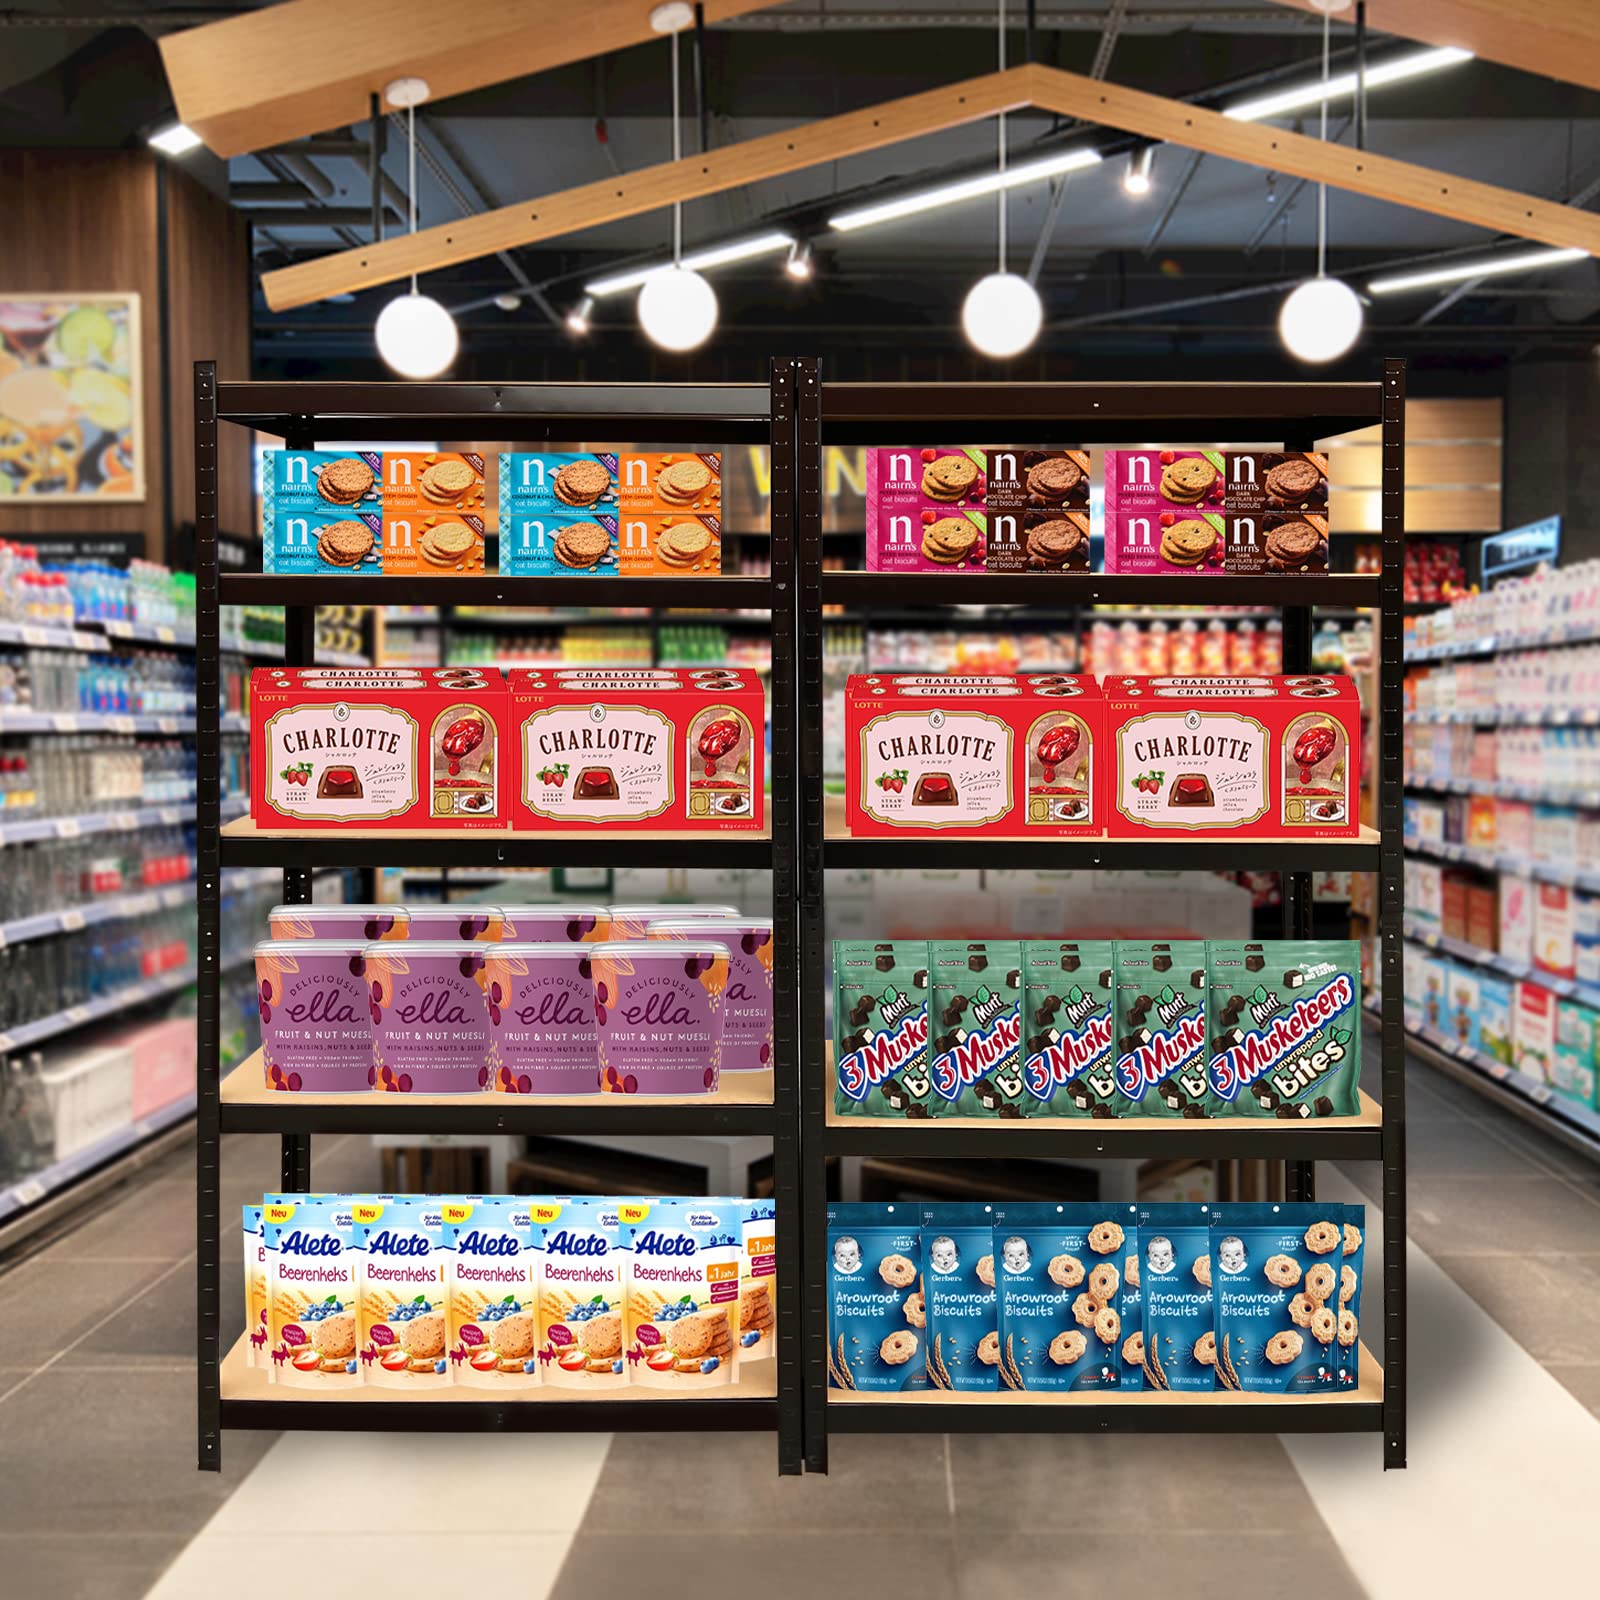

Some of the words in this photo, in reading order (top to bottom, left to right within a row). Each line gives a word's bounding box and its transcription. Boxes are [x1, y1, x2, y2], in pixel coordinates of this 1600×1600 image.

[287, 456, 308, 483] n
[390, 458, 411, 484] n
[523, 458, 544, 485] n
[626, 459, 647, 486] n
[890, 454, 912, 481] n
[995, 454, 1016, 480] n
[1128, 456, 1150, 483] n
[1234, 456, 1255, 482] n
[287, 518, 308, 545] n
[390, 520, 411, 546] n
[523, 520, 544, 547] n
[626, 521, 647, 548] n
[890, 516, 912, 543] n
[995, 516, 1016, 542] n
[1128, 518, 1150, 545] n
[1234, 518, 1255, 544] n
[320, 670, 398, 678] CHARLOTTE
[326, 680, 404, 688] CHARLOTTE
[582, 681, 660, 689] CHARLOTTE
[1171, 678, 1249, 686] CHARLOTTE
[921, 687, 999, 695] CHARLOTTE
[1177, 688, 1255, 696] CHARLOTTE
[283, 727, 400, 755] CHARLOTTE
[539, 728, 657, 756] CHARLOTTE
[878, 734, 996, 762] CHARLOTTE
[1134, 735, 1252, 763] CHARLOTTE
[290, 975, 360, 997] DELICIOUSLY
[400, 976, 470, 998] DELICIOUSLY
[520, 977, 590, 999] DELICIOUSLY
[626, 977, 696, 999] DELICIOUSLY
[881, 992, 910, 1022] Mint
[974, 992, 1004, 1022] Mint
[1067, 992, 1096, 1022] Mint
[1158, 992, 1188, 1022] Mint
[1251, 992, 1280, 1022] Mint
[275, 1030, 300, 1039] FRUIT
[304, 1030, 310, 1039] &
[316, 1030, 338, 1039] NUT
[385, 1032, 410, 1040] FRUIT
[414, 1032, 421, 1040] &
[426, 1032, 448, 1040] NUT
[453, 1032, 485, 1040] MUESLI
[505, 1032, 530, 1041] FRUIT
[534, 1032, 540, 1041] &
[546, 1032, 568, 1041] NUT
[611, 1032, 636, 1041] FRUIT
[640, 1032, 647, 1041] &
[652, 1032, 674, 1041] NUT
[679, 1032, 710, 1041] MUESLI
[1214, 1058, 1233, 1090] 3
[1234, 978, 1348, 1080] Musketeers
[1274, 1029, 1324, 1072] unwrapped
[844, 1058, 863, 1090] 3
[936, 1058, 956, 1090] 3
[1030, 1058, 1049, 1090] 3
[1120, 1058, 1140, 1090] 3
[1273, 1040, 1345, 1098] bites
[271, 1209, 287, 1218] Neu
[359, 1209, 375, 1218] Neu
[449, 1209, 465, 1218] Neu
[537, 1209, 553, 1218] Neu
[625, 1209, 641, 1218] Neu
[281, 1230, 342, 1256] Alete
[369, 1230, 430, 1256] Alete
[459, 1230, 519, 1256] Alete
[547, 1230, 608, 1256] Alete
[635, 1230, 696, 1256] Alete
[279, 1263, 348, 1282] Beerenkeks
[367, 1263, 436, 1282] Beerenkeks
[457, 1263, 526, 1282] Beerenkeks
[545, 1263, 614, 1282] Beerenkeks
[633, 1263, 702, 1282] Beerenkeks
[834, 1274, 862, 1282] Gerber
[931, 1274, 960, 1282] Gerber
[1003, 1274, 1032, 1282] Gerber
[1148, 1274, 1176, 1282] Gerber
[1219, 1274, 1248, 1282] Gerber
[836, 1290, 900, 1304] Arrowroot
[933, 1290, 998, 1304] Arrowroot
[1005, 1290, 1069, 1304] Arrowroot
[1150, 1290, 1214, 1304] Arrowroot
[1221, 1290, 1286, 1304] Arrowroot
[836, 1305, 884, 1317] Biscuits
[933, 1305, 982, 1317] Biscuits
[1005, 1305, 1054, 1317] Biscuits
[1150, 1305, 1198, 1317] Biscuits
[1221, 1305, 1270, 1317] Biscuits
